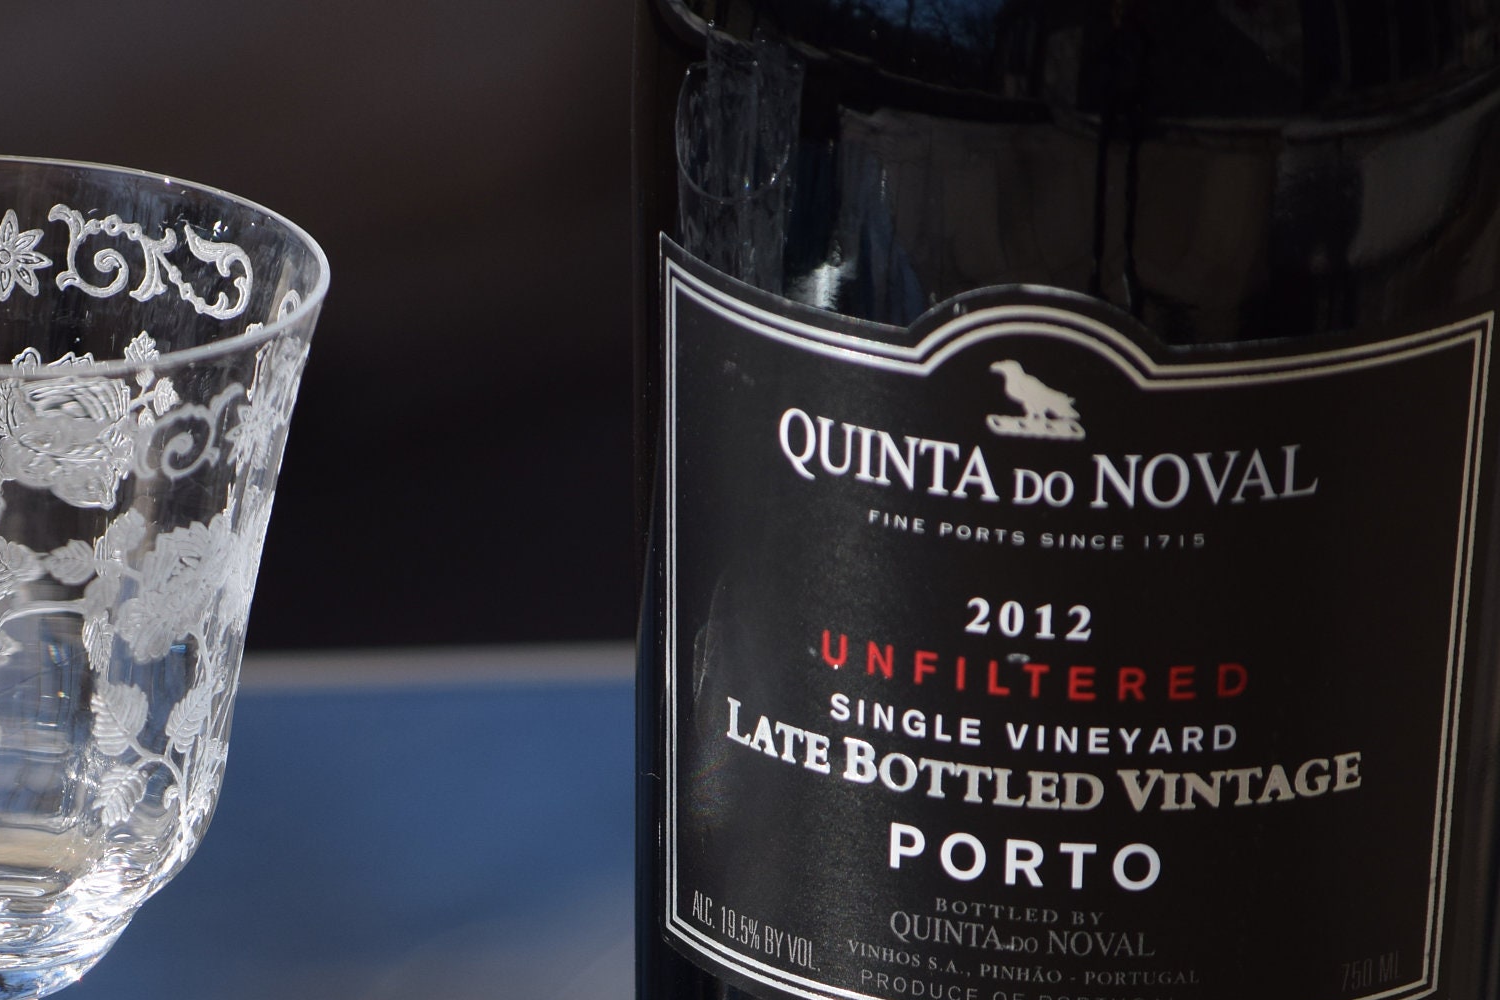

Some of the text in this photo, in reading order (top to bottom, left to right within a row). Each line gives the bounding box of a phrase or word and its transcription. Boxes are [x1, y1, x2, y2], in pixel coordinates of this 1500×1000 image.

[779, 408, 1319, 509] QUINTA DO NOVAL
[868, 509, 1207, 550] FINE PORTS SINCE 1715
[965, 597, 1092, 642] 2012
[823, 629, 1249, 702] UNFILTERED
[831, 693, 1238, 754] SINGLE VINEYARD
[727, 697, 1363, 812] LATE BOTTLED VINTAGE
[890, 822, 1162, 891] PORTO
[692, 890, 821, 972] ALC. 19.5% BY VOL.
[890, 910, 1156, 957] QUINTA DO NOVAL
[935, 897, 1105, 926] BOTTLED BY
[847, 939, 921, 967] VINHOS
[1084, 970, 1200, 987] PORTUGAL
[1341, 958, 1373, 992] 750
